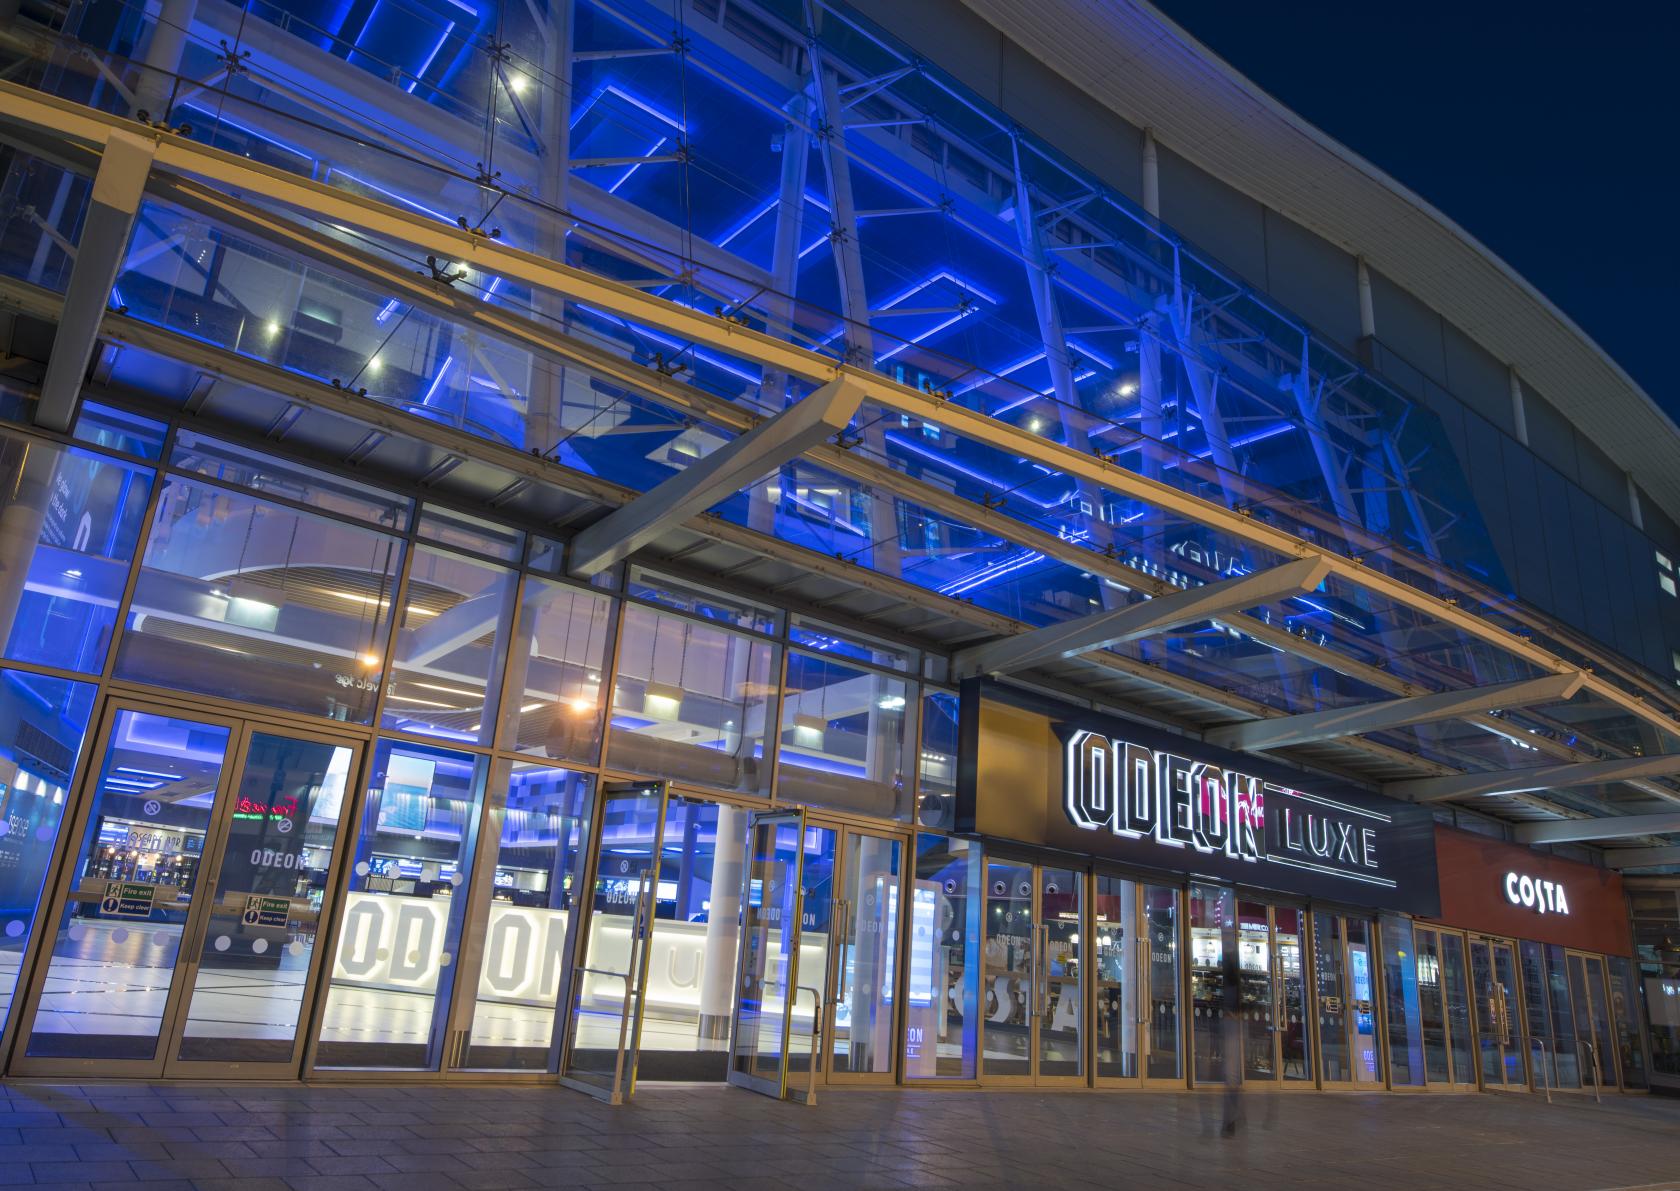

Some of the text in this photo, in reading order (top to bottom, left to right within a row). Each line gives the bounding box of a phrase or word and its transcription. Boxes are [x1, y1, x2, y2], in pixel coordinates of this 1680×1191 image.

[1063, 729, 1379, 868] ODEON LUXE
[250, 849, 305, 870] ODEON
[124, 887, 152, 896] Fire exit
[1505, 872, 1570, 914] COSTA
[120, 903, 134, 911] Keep
[275, 902, 289, 910] exit
[260, 914, 273, 922] Keep
